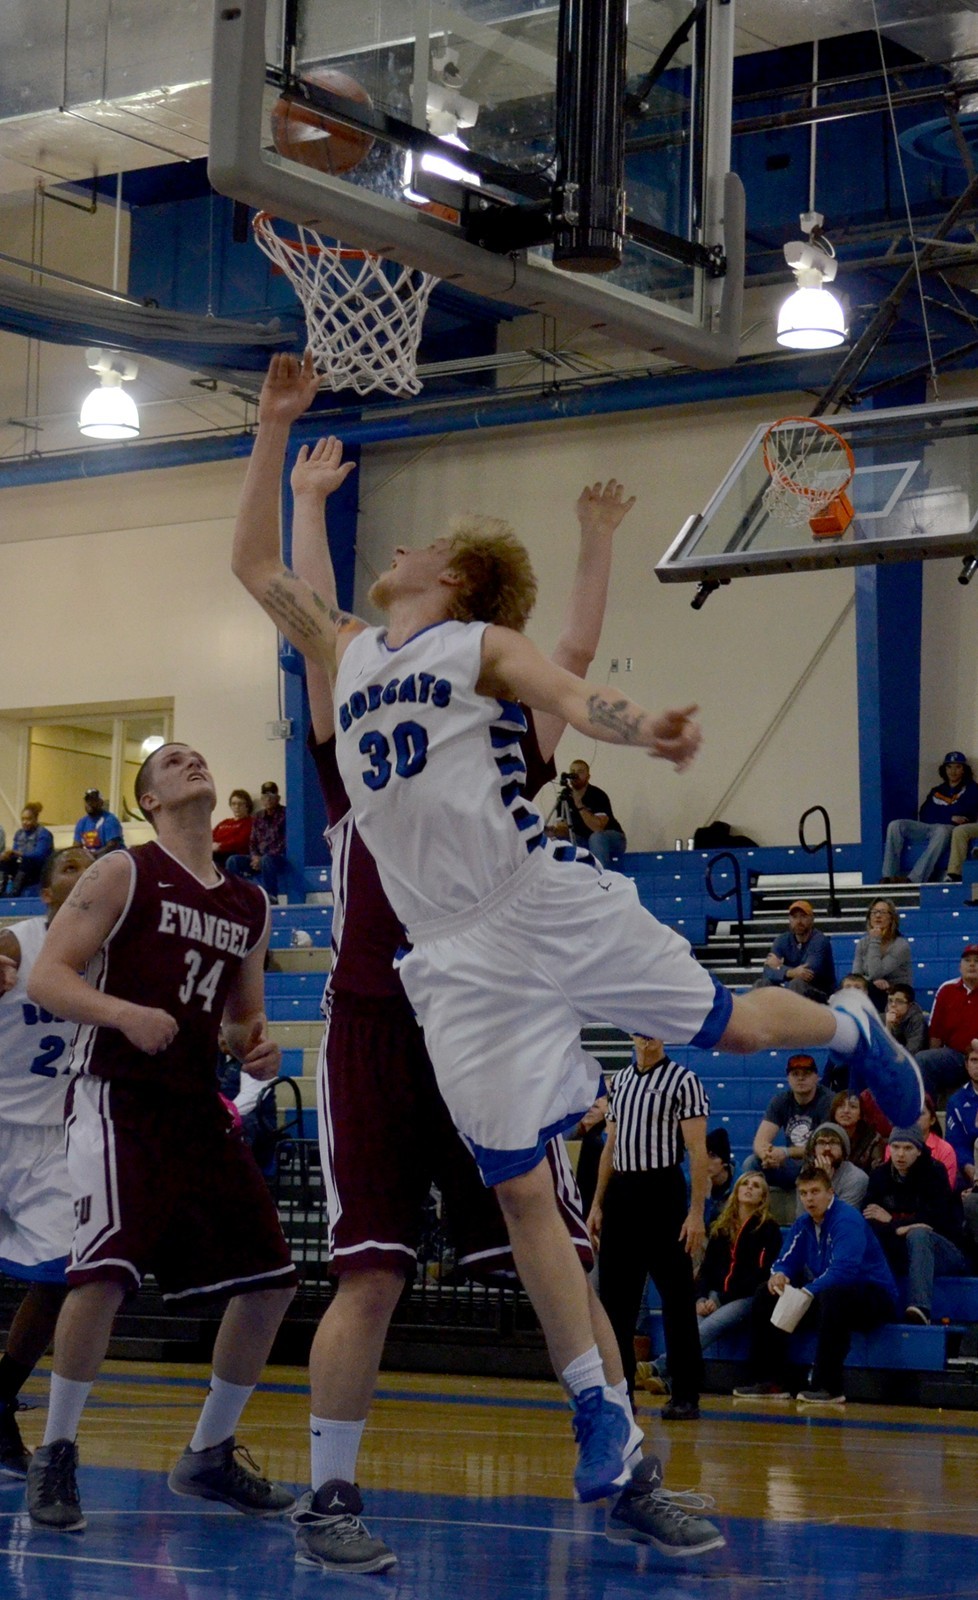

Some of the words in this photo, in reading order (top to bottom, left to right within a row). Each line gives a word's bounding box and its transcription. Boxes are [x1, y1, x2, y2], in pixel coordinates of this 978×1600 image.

[339, 672, 452, 732] BOBCATS
[359, 720, 429, 791] 30
[158, 900, 249, 958] EVANGEL
[178, 948, 225, 1013] 34
